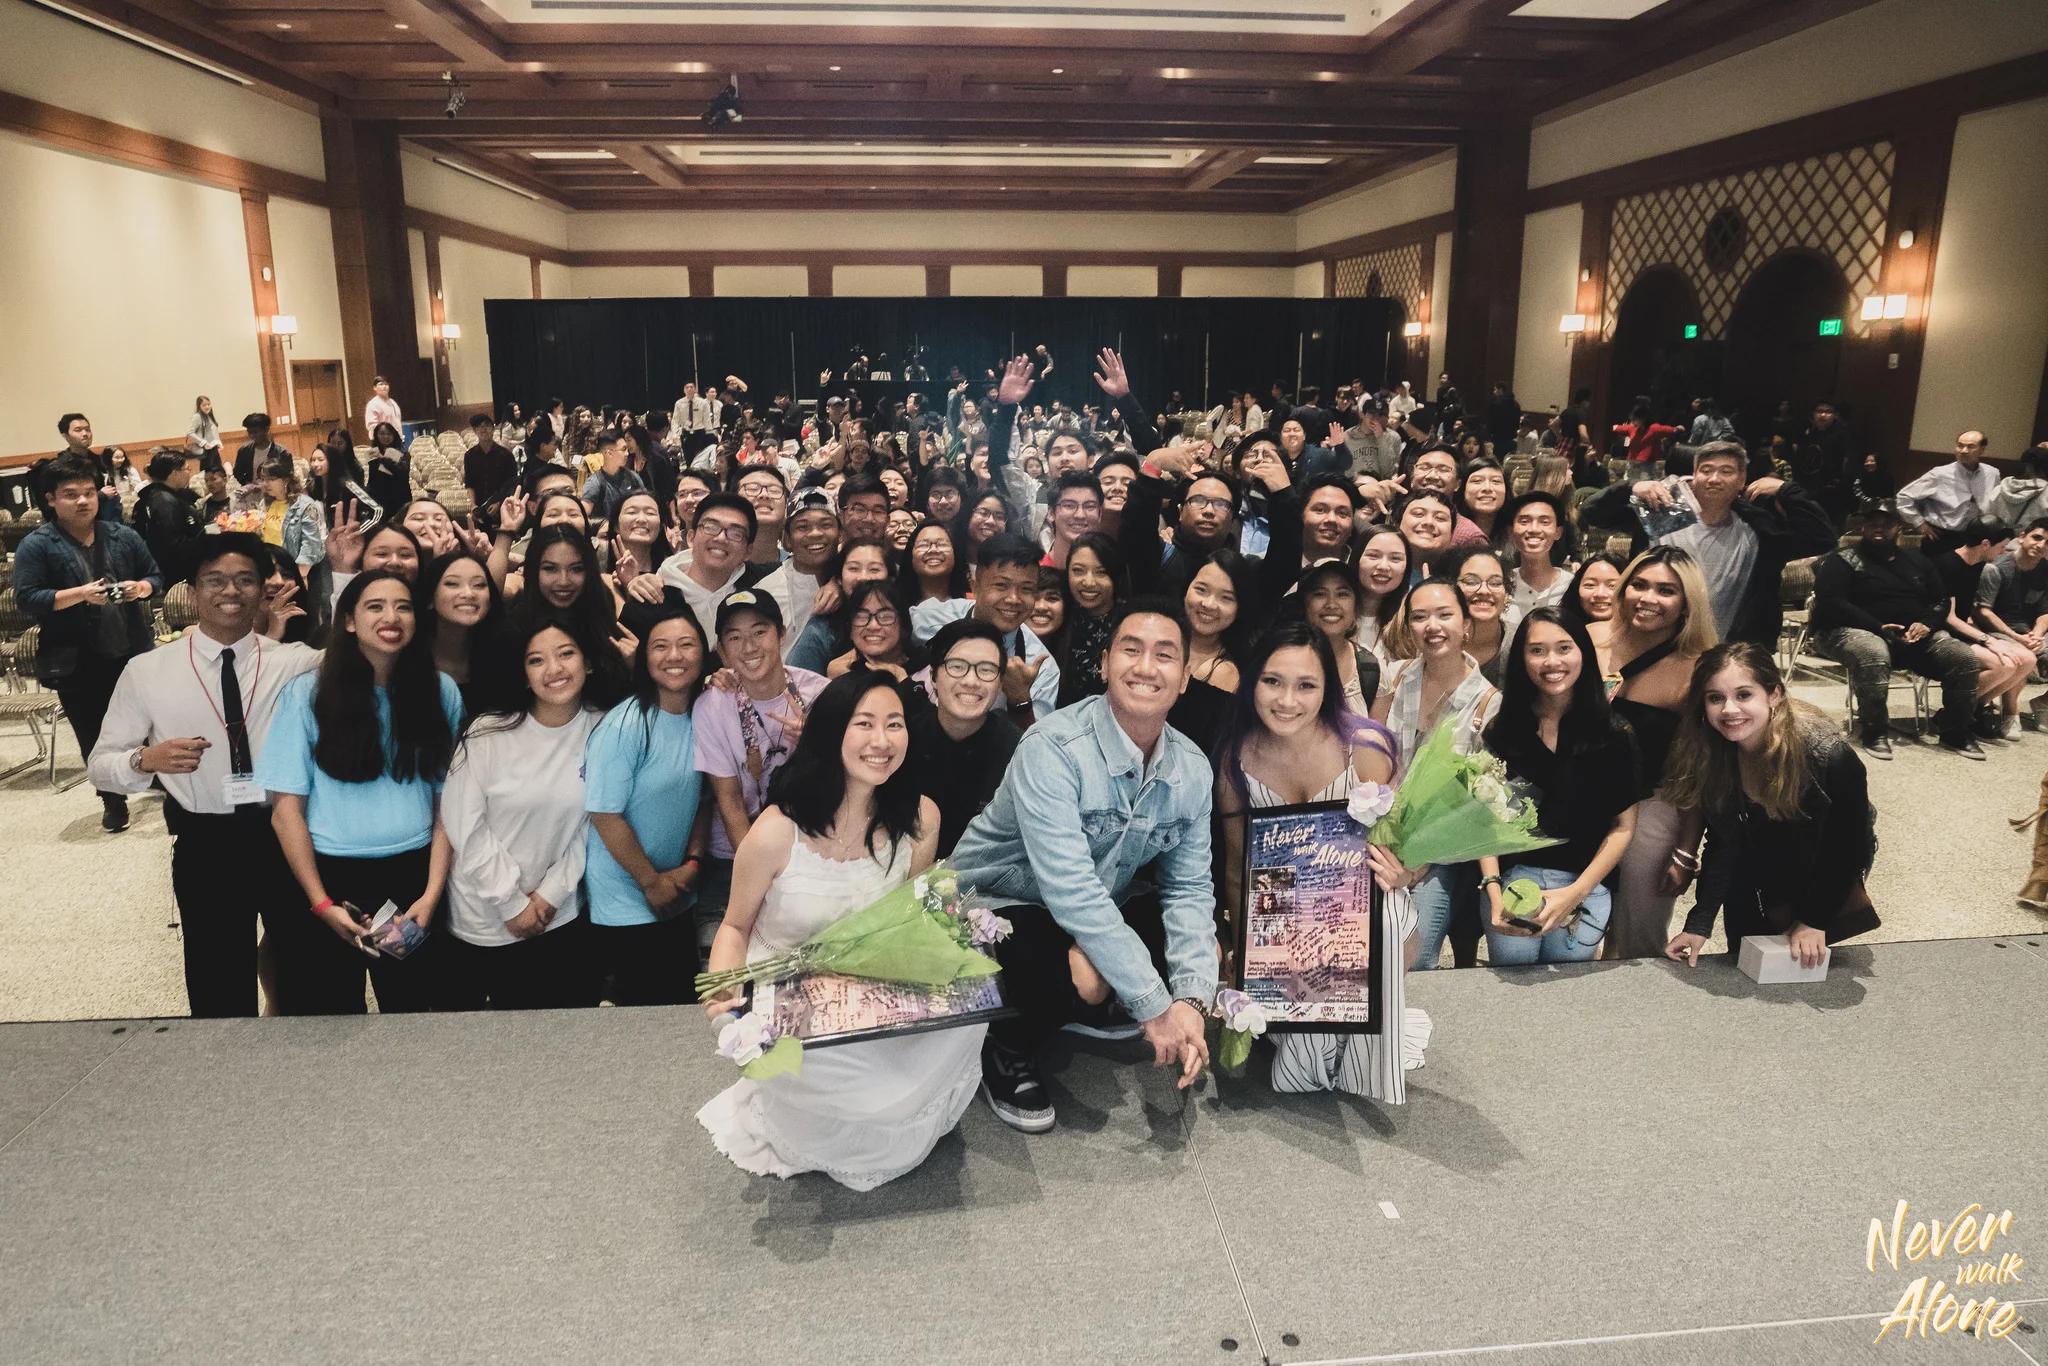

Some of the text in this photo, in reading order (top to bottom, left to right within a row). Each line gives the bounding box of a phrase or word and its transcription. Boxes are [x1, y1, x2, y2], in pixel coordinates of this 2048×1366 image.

[1263, 823, 1316, 852] Never
[1293, 840, 1319, 856] walk
[1310, 843, 1363, 872] Alone
